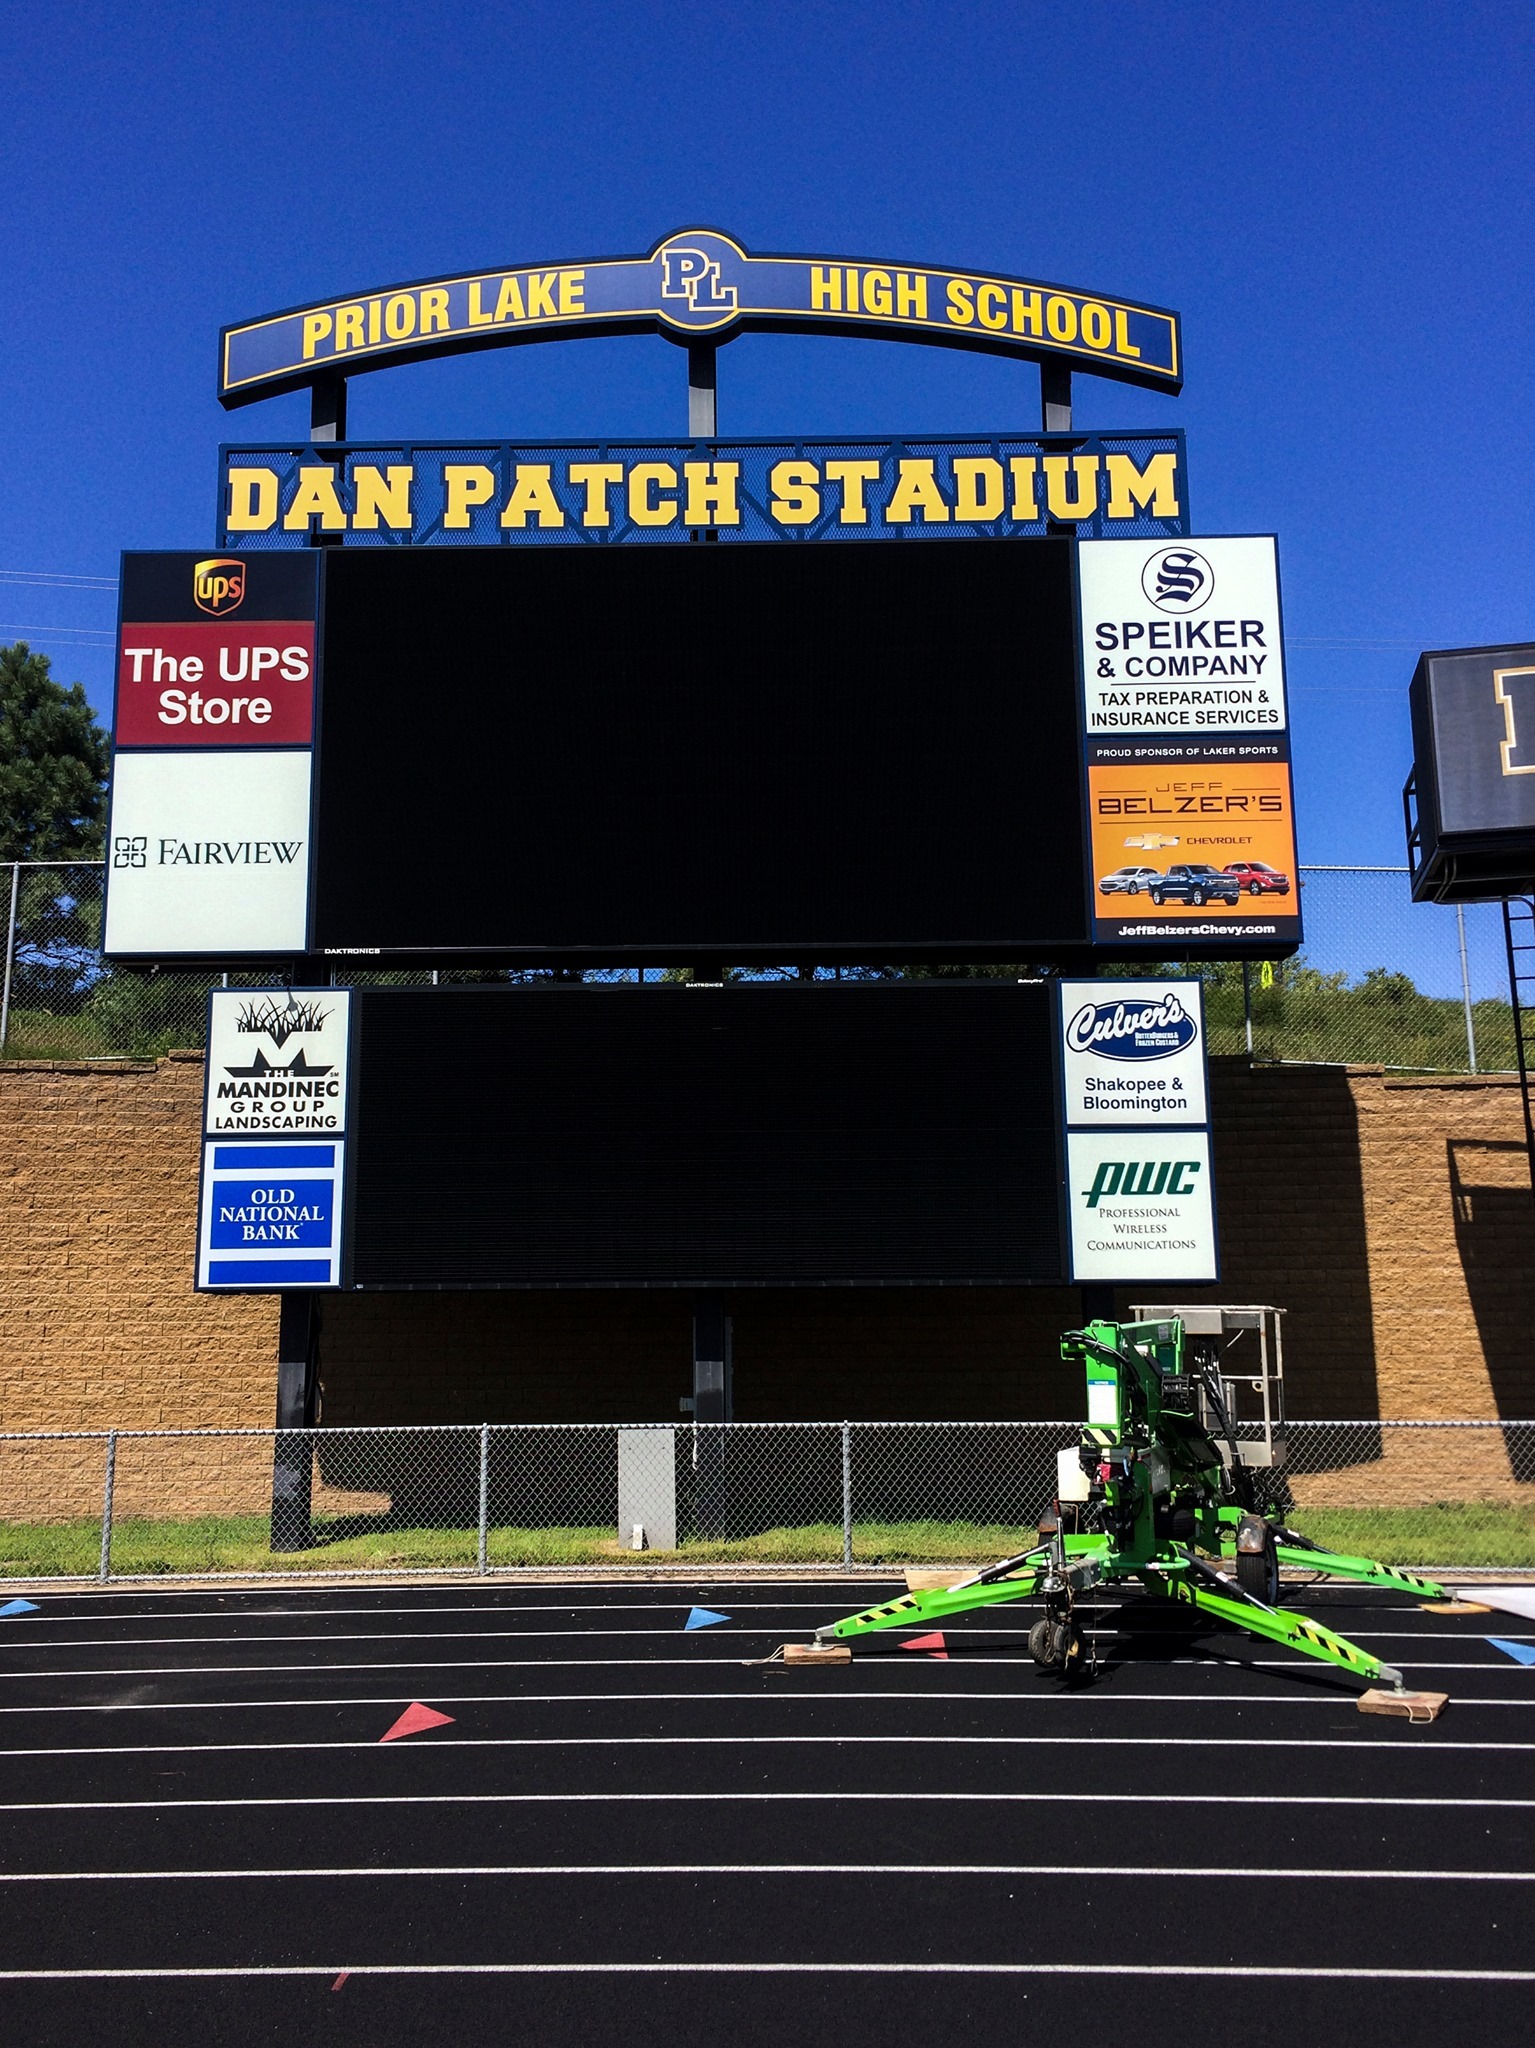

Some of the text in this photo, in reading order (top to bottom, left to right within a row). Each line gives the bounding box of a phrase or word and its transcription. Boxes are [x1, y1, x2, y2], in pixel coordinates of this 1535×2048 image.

[302, 270, 585, 359] PRIOR LAKE
[810, 266, 1141, 358] HIGH SCHOOL
[226, 453, 1179, 531] DAN PATCH STADIUM
[198, 576, 241, 607] ups
[1095, 619, 1267, 650] SPEIKER
[124, 646, 310, 682] The UPS
[1096, 654, 1268, 678] & COMPANY
[1098, 690, 1269, 706] TAX PREPARATION &
[157, 689, 273, 725] Store
[1091, 709, 1279, 726] INSURANCE SERVICES
[1096, 746, 1279, 757] PROUD SPONSOR OF LAKER SPORTS
[1155, 782, 1222, 792] JEFF
[1098, 795, 1282, 814] BELZER'S
[1186, 836, 1252, 845] CHEVROLET
[1118, 924, 1276, 936] JeffBelzersChevy.com
[1067, 993, 1185, 1052] Culver's
[263, 1069, 295, 1078] THE
[216, 1081, 339, 1098] MANDINEC
[1085, 1077, 1183, 1094] Shakopee &
[230, 1100, 324, 1113] GROUP
[1083, 1096, 1187, 1112] Bloomington
[215, 1115, 337, 1129] LANDSCAPING
[251, 1189, 295, 1204] OLD
[219, 1205, 324, 1222] NATIONAL
[242, 1224, 300, 1241] BANK
